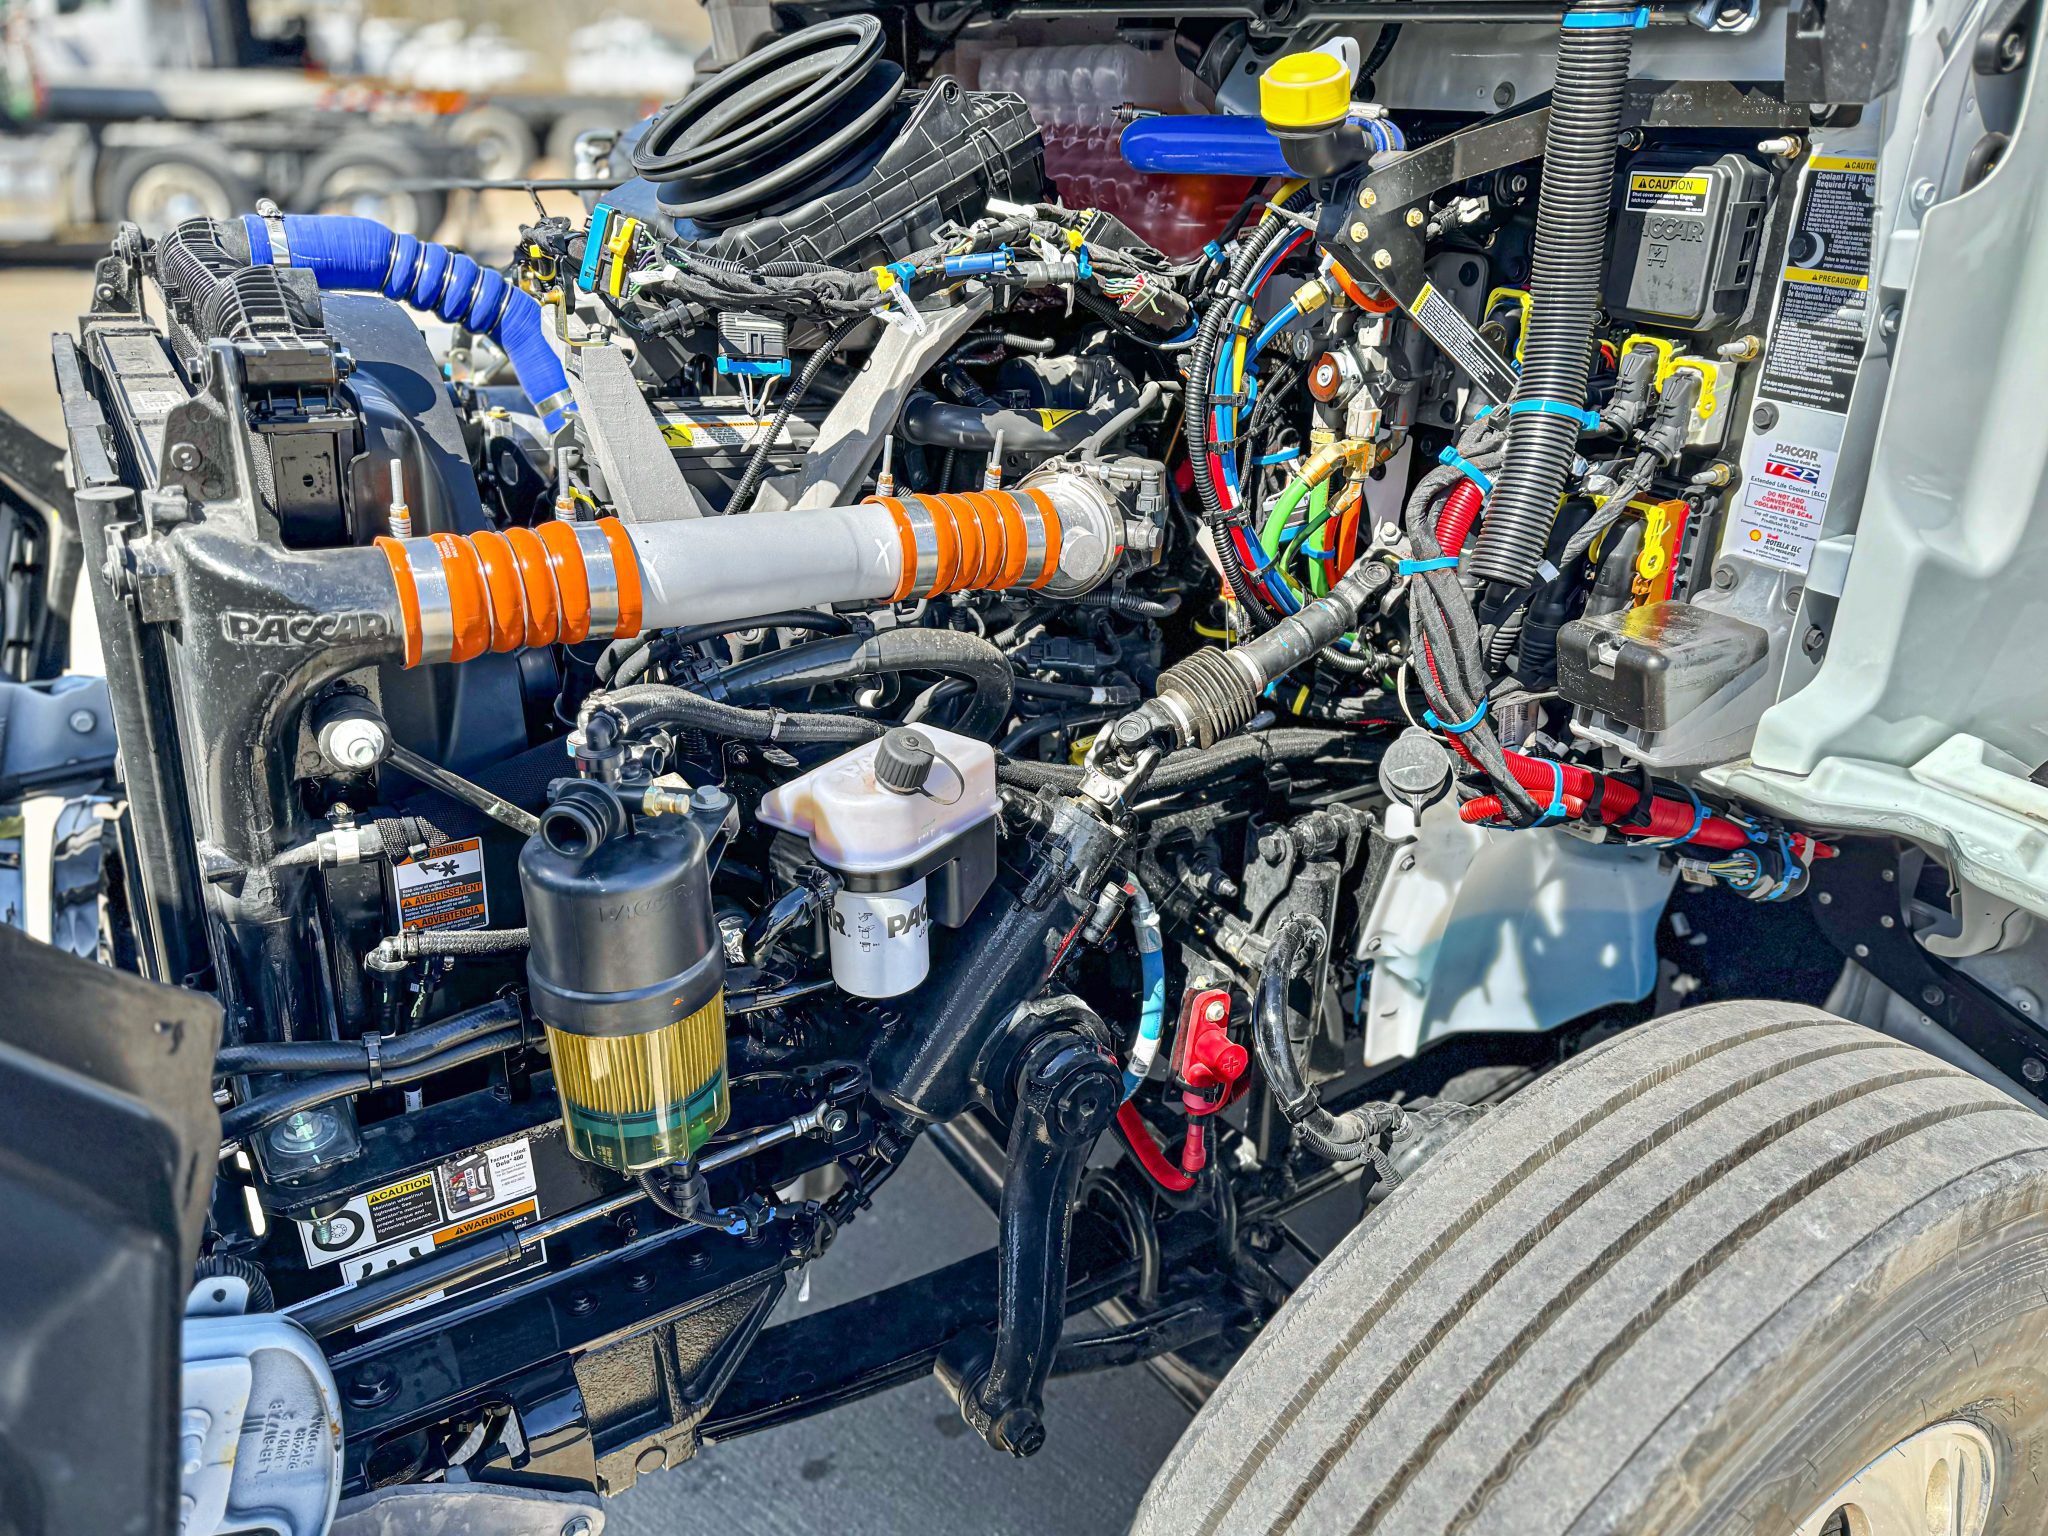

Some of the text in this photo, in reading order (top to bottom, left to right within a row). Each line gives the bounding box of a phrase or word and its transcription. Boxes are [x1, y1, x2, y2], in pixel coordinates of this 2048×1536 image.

[1851, 161, 1877, 170] CAUTIO
[1818, 172, 1843, 181] Coolant
[1648, 179, 1693, 190] CAUTION
[1816, 180, 1846, 189] Required
[1848, 182, 1860, 190] For
[1818, 274, 1861, 286] PRECAUCION
[1789, 282, 1822, 292] Procedimiento
[1823, 286, 1848, 297] Requerido
[1795, 291, 1824, 302] Refrigerante
[1832, 295, 1842, 303] Este
[1412, 286, 1431, 313] CAUTION
[1775, 443, 1819, 461] PACCAR
[1766, 462, 1820, 484] TRP
[1751, 476, 1775, 486] Extended
[1789, 485, 1810, 495] Coolant
[1811, 490, 1828, 500] (ELC)
[1754, 500, 1785, 512] COOLANTS
[1762, 496, 1807, 511] CONVENTIONAL
[1791, 545, 1802, 553] ELC
[225, 611, 390, 645] PACCAR
[431, 844, 464, 858] ARNING
[415, 882, 481, 905] AVERTISSEMENT
[421, 906, 480, 926] ADVERTENCIA
[888, 897, 927, 938] PAC
[380, 1177, 431, 1199] CAUTION
[372, 1202, 397, 1211] Maintain
[404, 1203, 424, 1213] manual
[377, 1219, 395, 1229] proper
[396, 1213, 413, 1222] torque
[464, 1209, 515, 1231] WARNING
